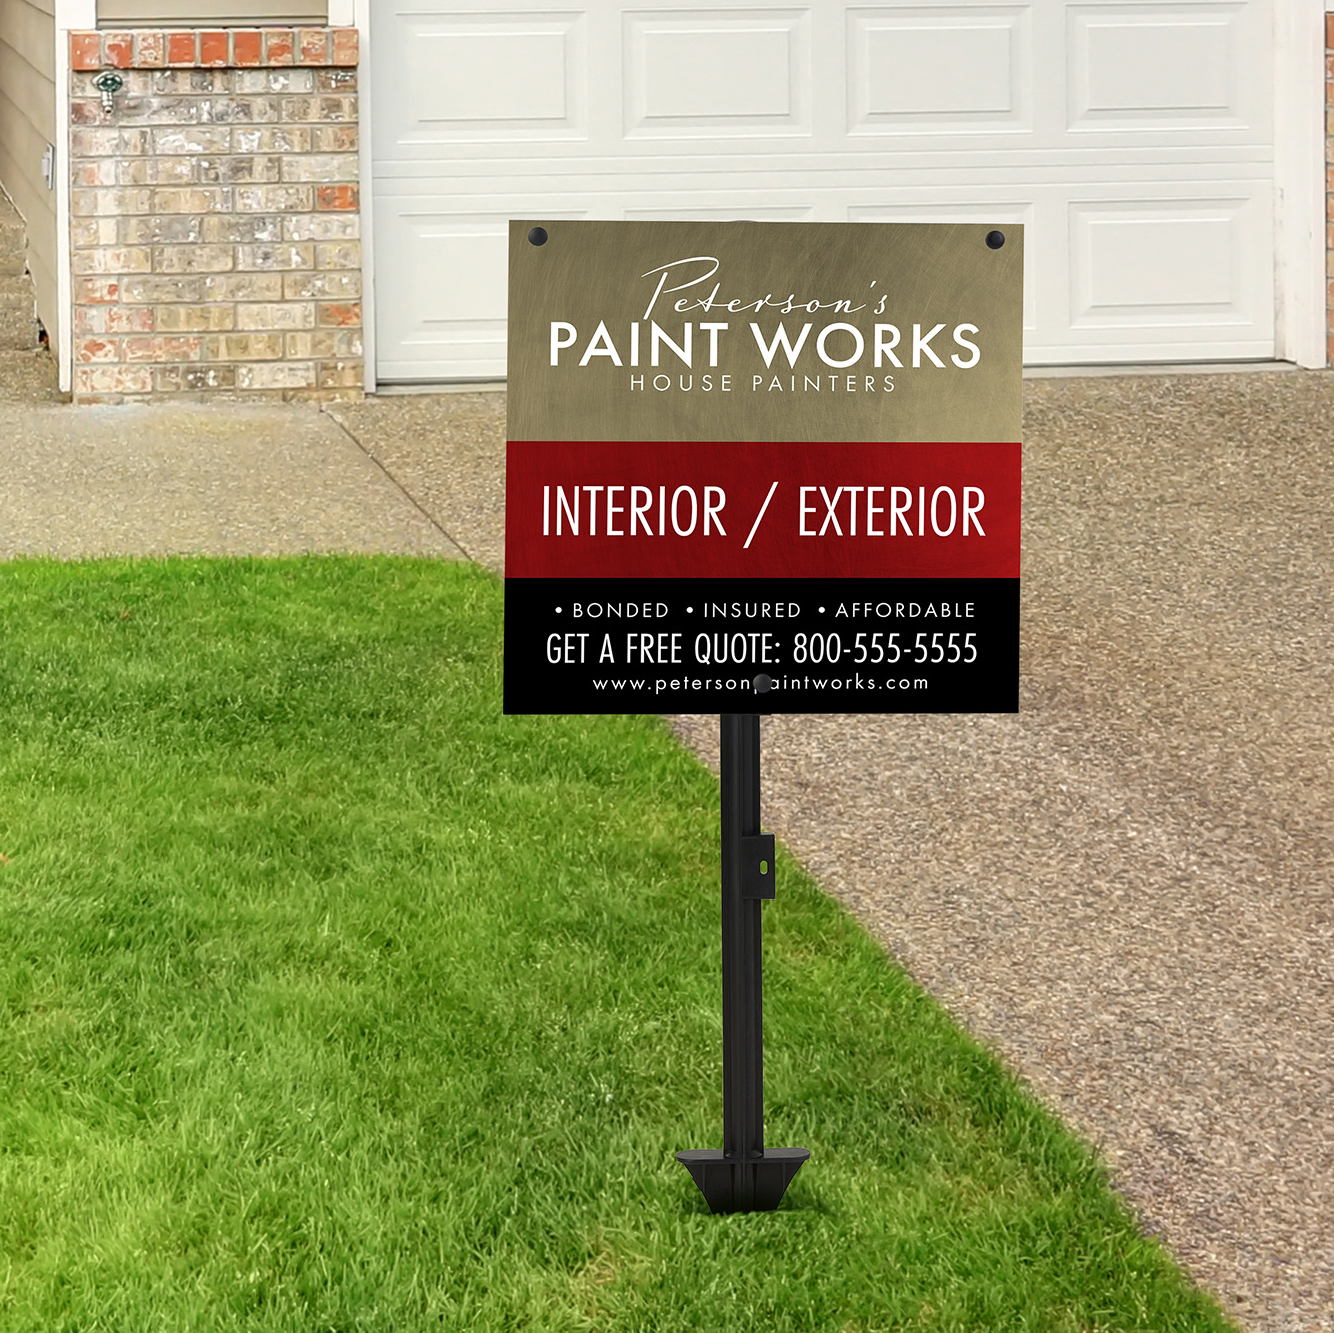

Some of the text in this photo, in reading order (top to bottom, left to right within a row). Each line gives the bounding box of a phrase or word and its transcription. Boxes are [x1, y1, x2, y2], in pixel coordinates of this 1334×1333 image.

[641, 256, 888, 320] Peterson's
[550, 320, 981, 369] PAINT WORKS
[630, 374, 895, 393] HOUSE PAINTERS
[543, 485, 727, 537] INTERIOR
[799, 486, 986, 537] EXTERIOR
[573, 602, 975, 618] BONDED INSURED AFFORDABLE
[546, 632, 977, 665] GET A FREE QUOTE: 800-555-5555
[592, 672, 928, 695] www.petersonaintworks.com
